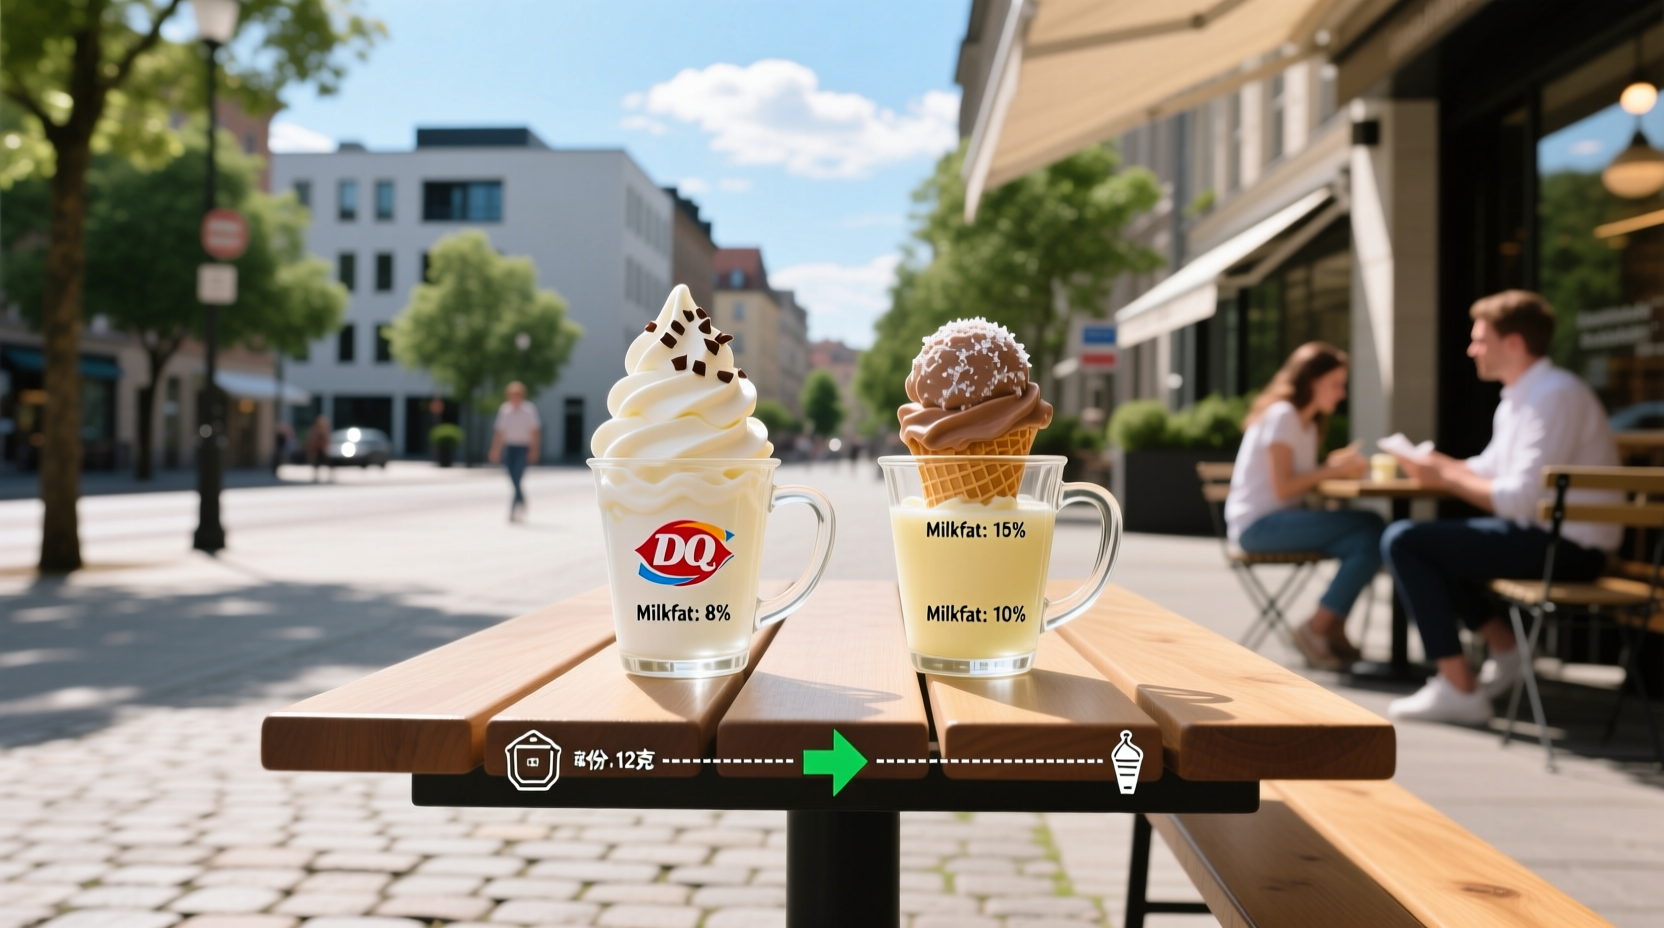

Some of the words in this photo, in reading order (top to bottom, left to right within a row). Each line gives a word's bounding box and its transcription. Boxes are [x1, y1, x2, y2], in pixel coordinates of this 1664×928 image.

[926, 520, 988, 538] Milkfat:
[993, 521, 1026, 538] 15%
[652, 533, 717, 572] DQ
[636, 603, 700, 622] Milkfat:
[704, 603, 731, 622] 8%
[926, 604, 988, 622] Milkfat:
[993, 605, 1026, 622] 10%
